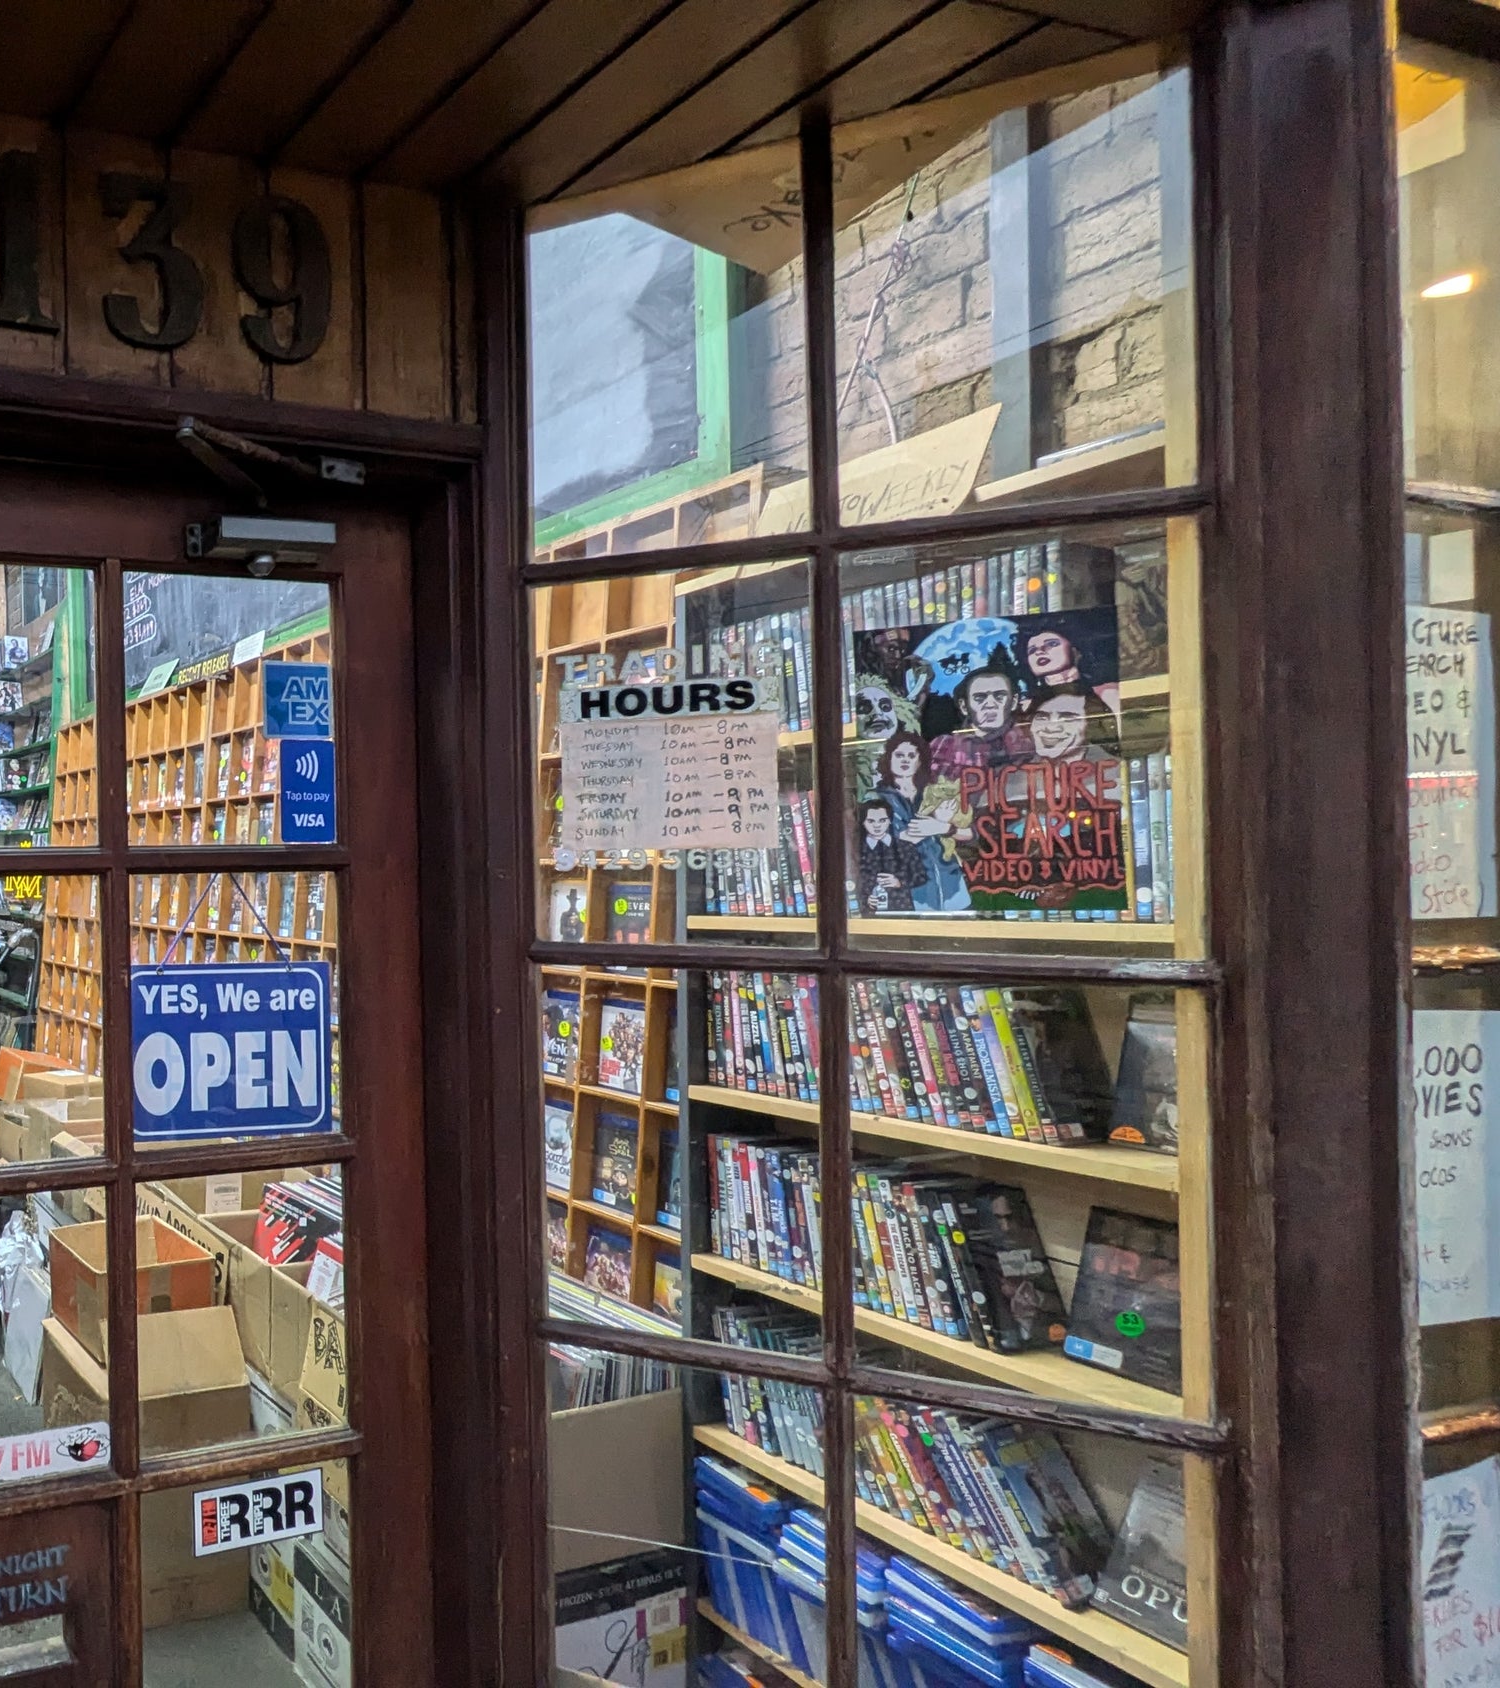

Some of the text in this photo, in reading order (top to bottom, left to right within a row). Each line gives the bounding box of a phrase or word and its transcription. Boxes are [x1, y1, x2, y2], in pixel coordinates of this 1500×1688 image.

[857, 460, 969, 523] WEEKLY
[1411, 617, 1480, 648] CTURE
[555, 640, 783, 683] TRADING
[1406, 654, 1466, 677] EARCH
[581, 680, 756, 718] HOURS
[582, 741, 634, 752] TUESDAY
[583, 724, 639, 739] MONDAY
[1412, 725, 1466, 765] NYL
[580, 775, 634, 788] THURSDAY
[581, 757, 642, 770] WEDNESDAY
[285, 791, 330, 802] Tap to pay
[576, 792, 627, 804] FRIDAY
[960, 758, 1120, 814] PICTURE
[292, 814, 325, 828] VISA
[577, 808, 639, 822] SATURDAY
[575, 828, 625, 840] SUNDAY
[975, 809, 1118, 860] SEARCH
[962, 859, 1033, 883] VIDEO
[1061, 859, 1125, 881] VINYL
[138, 983, 316, 1020] YES, We are
[750, 1010, 761, 1045] MUZZLE
[902, 1032, 920, 1077] TOUCH
[948, 1029, 971, 1081] SLINGSHOT
[962, 1032, 982, 1079] APARTMENT
[975, 1038, 1000, 1104] PROBLEMISTA
[1416, 1043, 1483, 1079] ,000
[133, 1029, 317, 1117] OPEN
[1421, 1081, 1483, 1118] VIES
[742, 1181, 752, 1214] HOMICIDE
[901, 1226, 922, 1296] BACK TO BLACK
[11, 1439, 51, 1472] FM
[219, 1480, 316, 1544] RRR
[220, 1500, 230, 1540] THREE
[253, 1492, 264, 1536] TRIPLE
[560, 1592, 592, 1608] FROZEN
